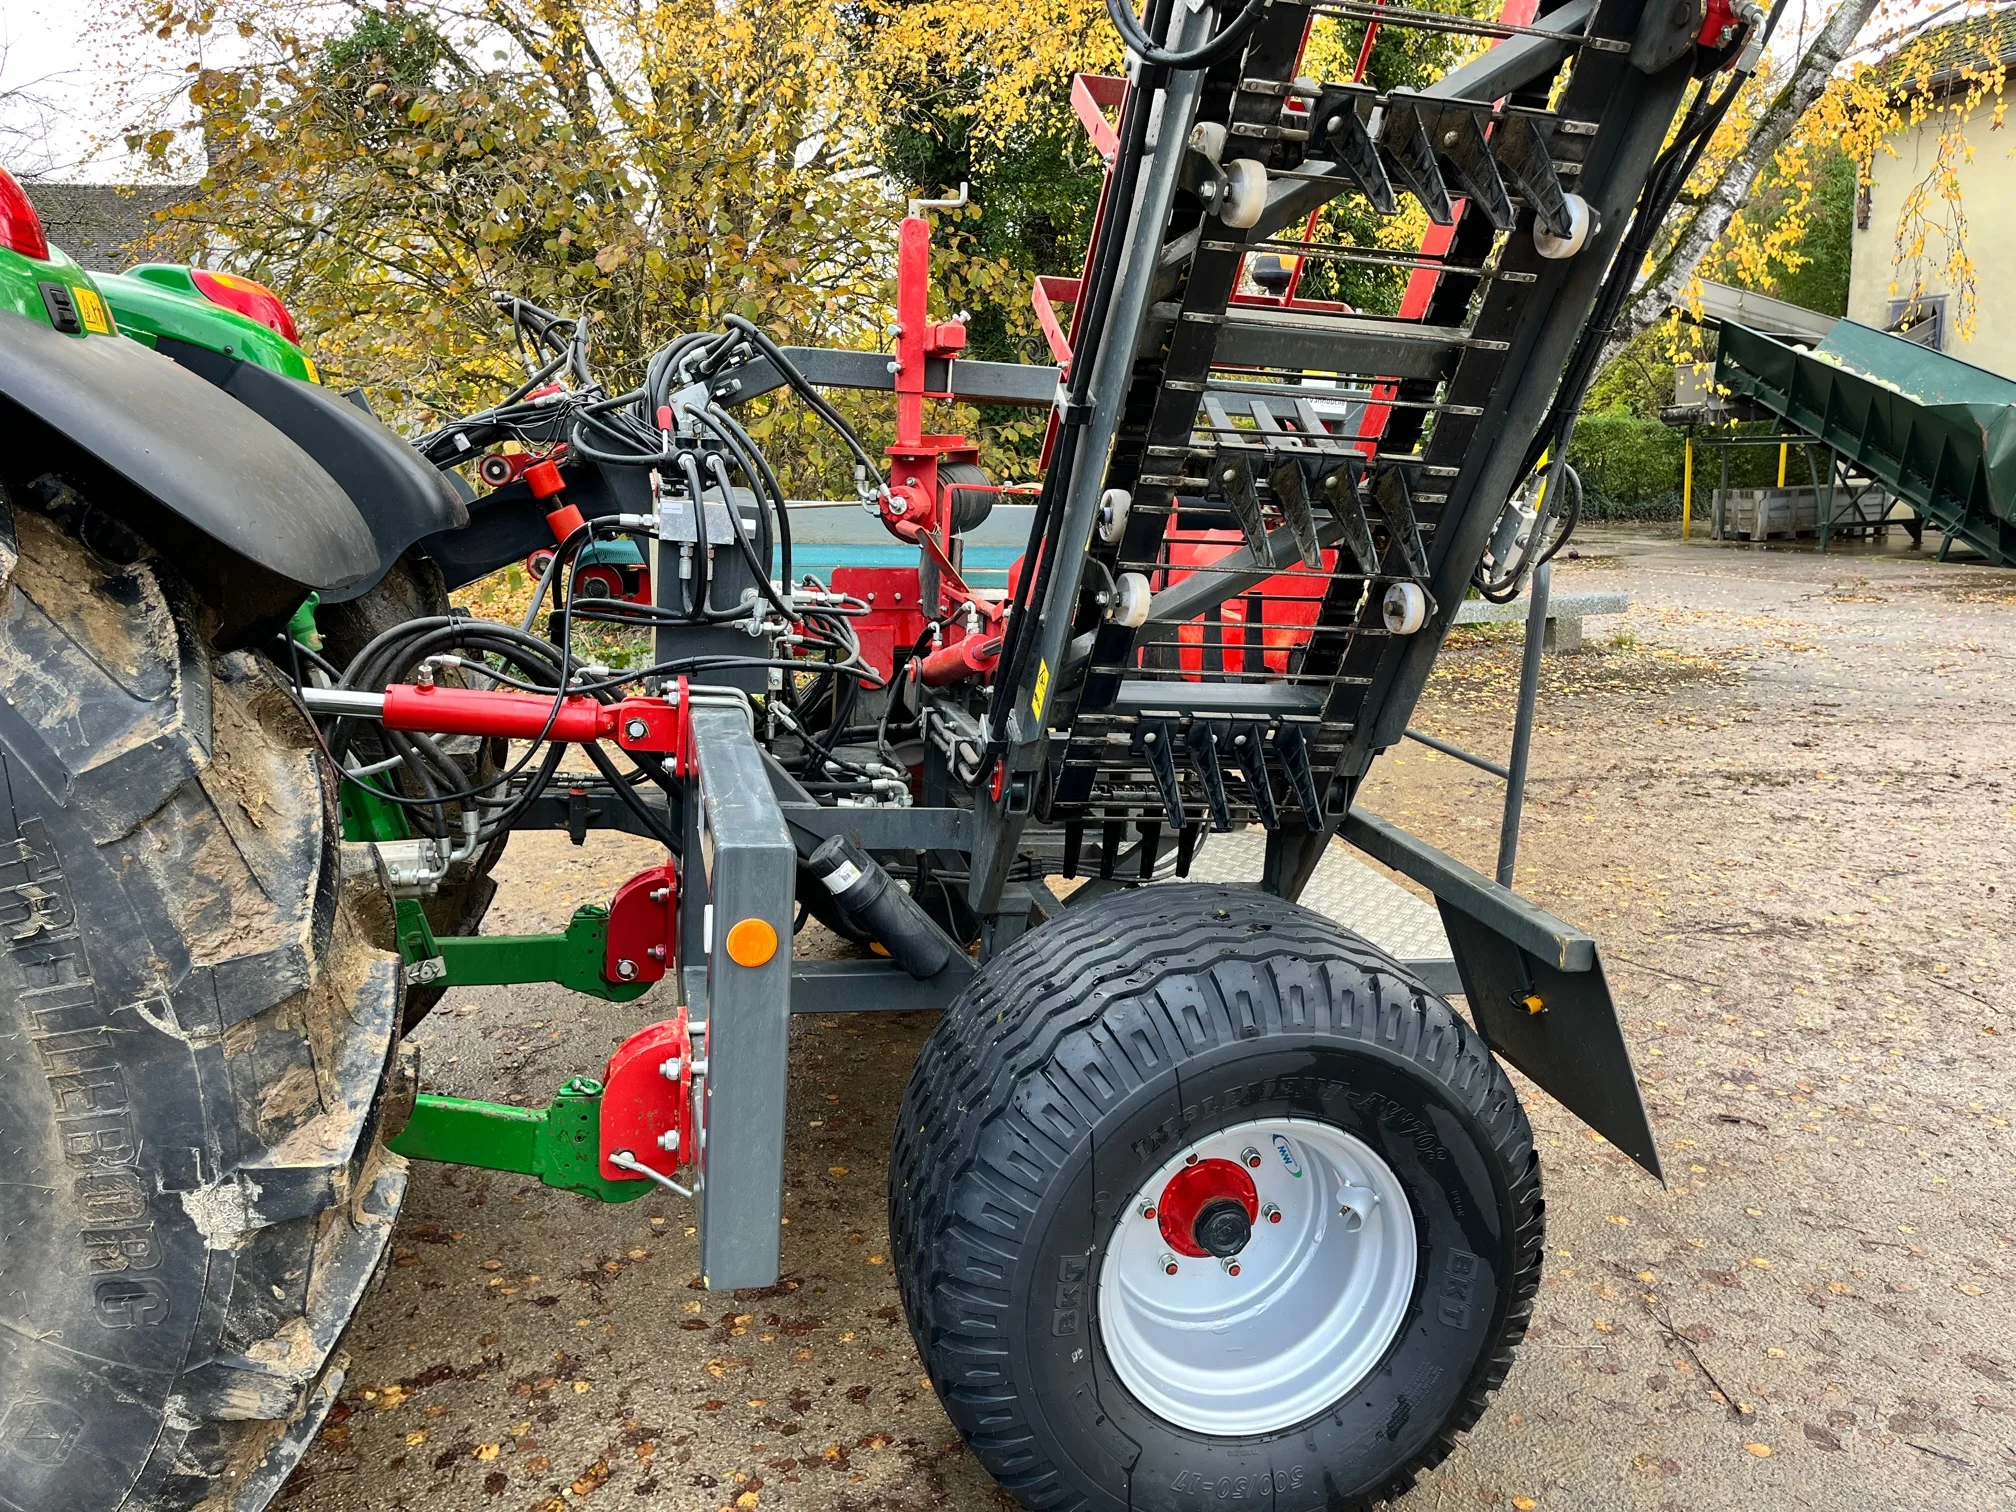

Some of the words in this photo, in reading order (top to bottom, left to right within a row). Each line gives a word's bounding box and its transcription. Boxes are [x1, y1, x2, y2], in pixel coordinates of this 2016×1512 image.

[1055, 1257, 1086, 1336] BKT
[1441, 1251, 1476, 1327] BKT
[1170, 1464, 1305, 1499] 500/50-17
